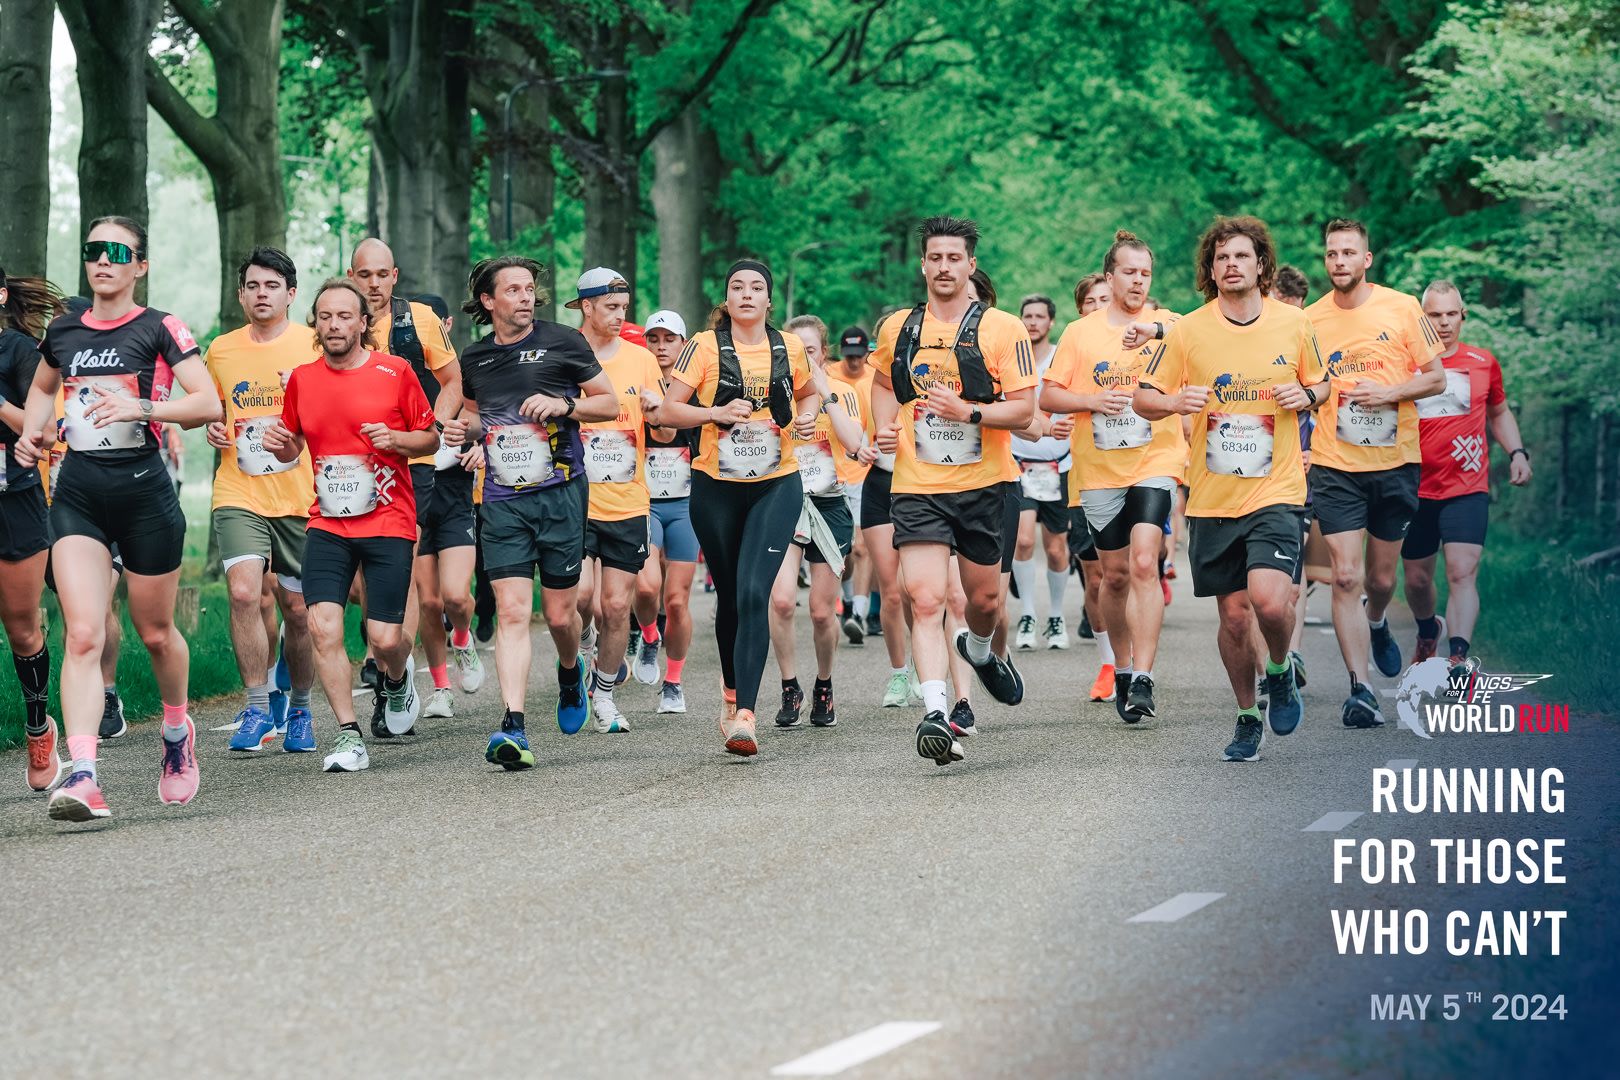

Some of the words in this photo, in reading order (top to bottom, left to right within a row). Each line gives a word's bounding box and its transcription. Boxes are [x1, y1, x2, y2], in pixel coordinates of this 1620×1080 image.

[69, 347, 125, 376] flott.
[1336, 362, 1366, 375] WORLD
[1366, 360, 1384, 371] RUN
[1223, 390, 1258, 402] WORLD
[1258, 389, 1275, 401] RU
[241, 396, 273, 407] WORLD
[1105, 417, 1136, 428] 67449
[1351, 416, 1383, 426] 67343
[929, 430, 964, 441] 67862
[733, 446, 767, 457] 68309
[1222, 441, 1257, 453] 68340
[501, 451, 533, 462] 66937
[592, 453, 623, 462] 66942
[650, 470, 677, 479] 67591
[799, 467, 821, 477] 7589
[328, 482, 360, 493] 67487
